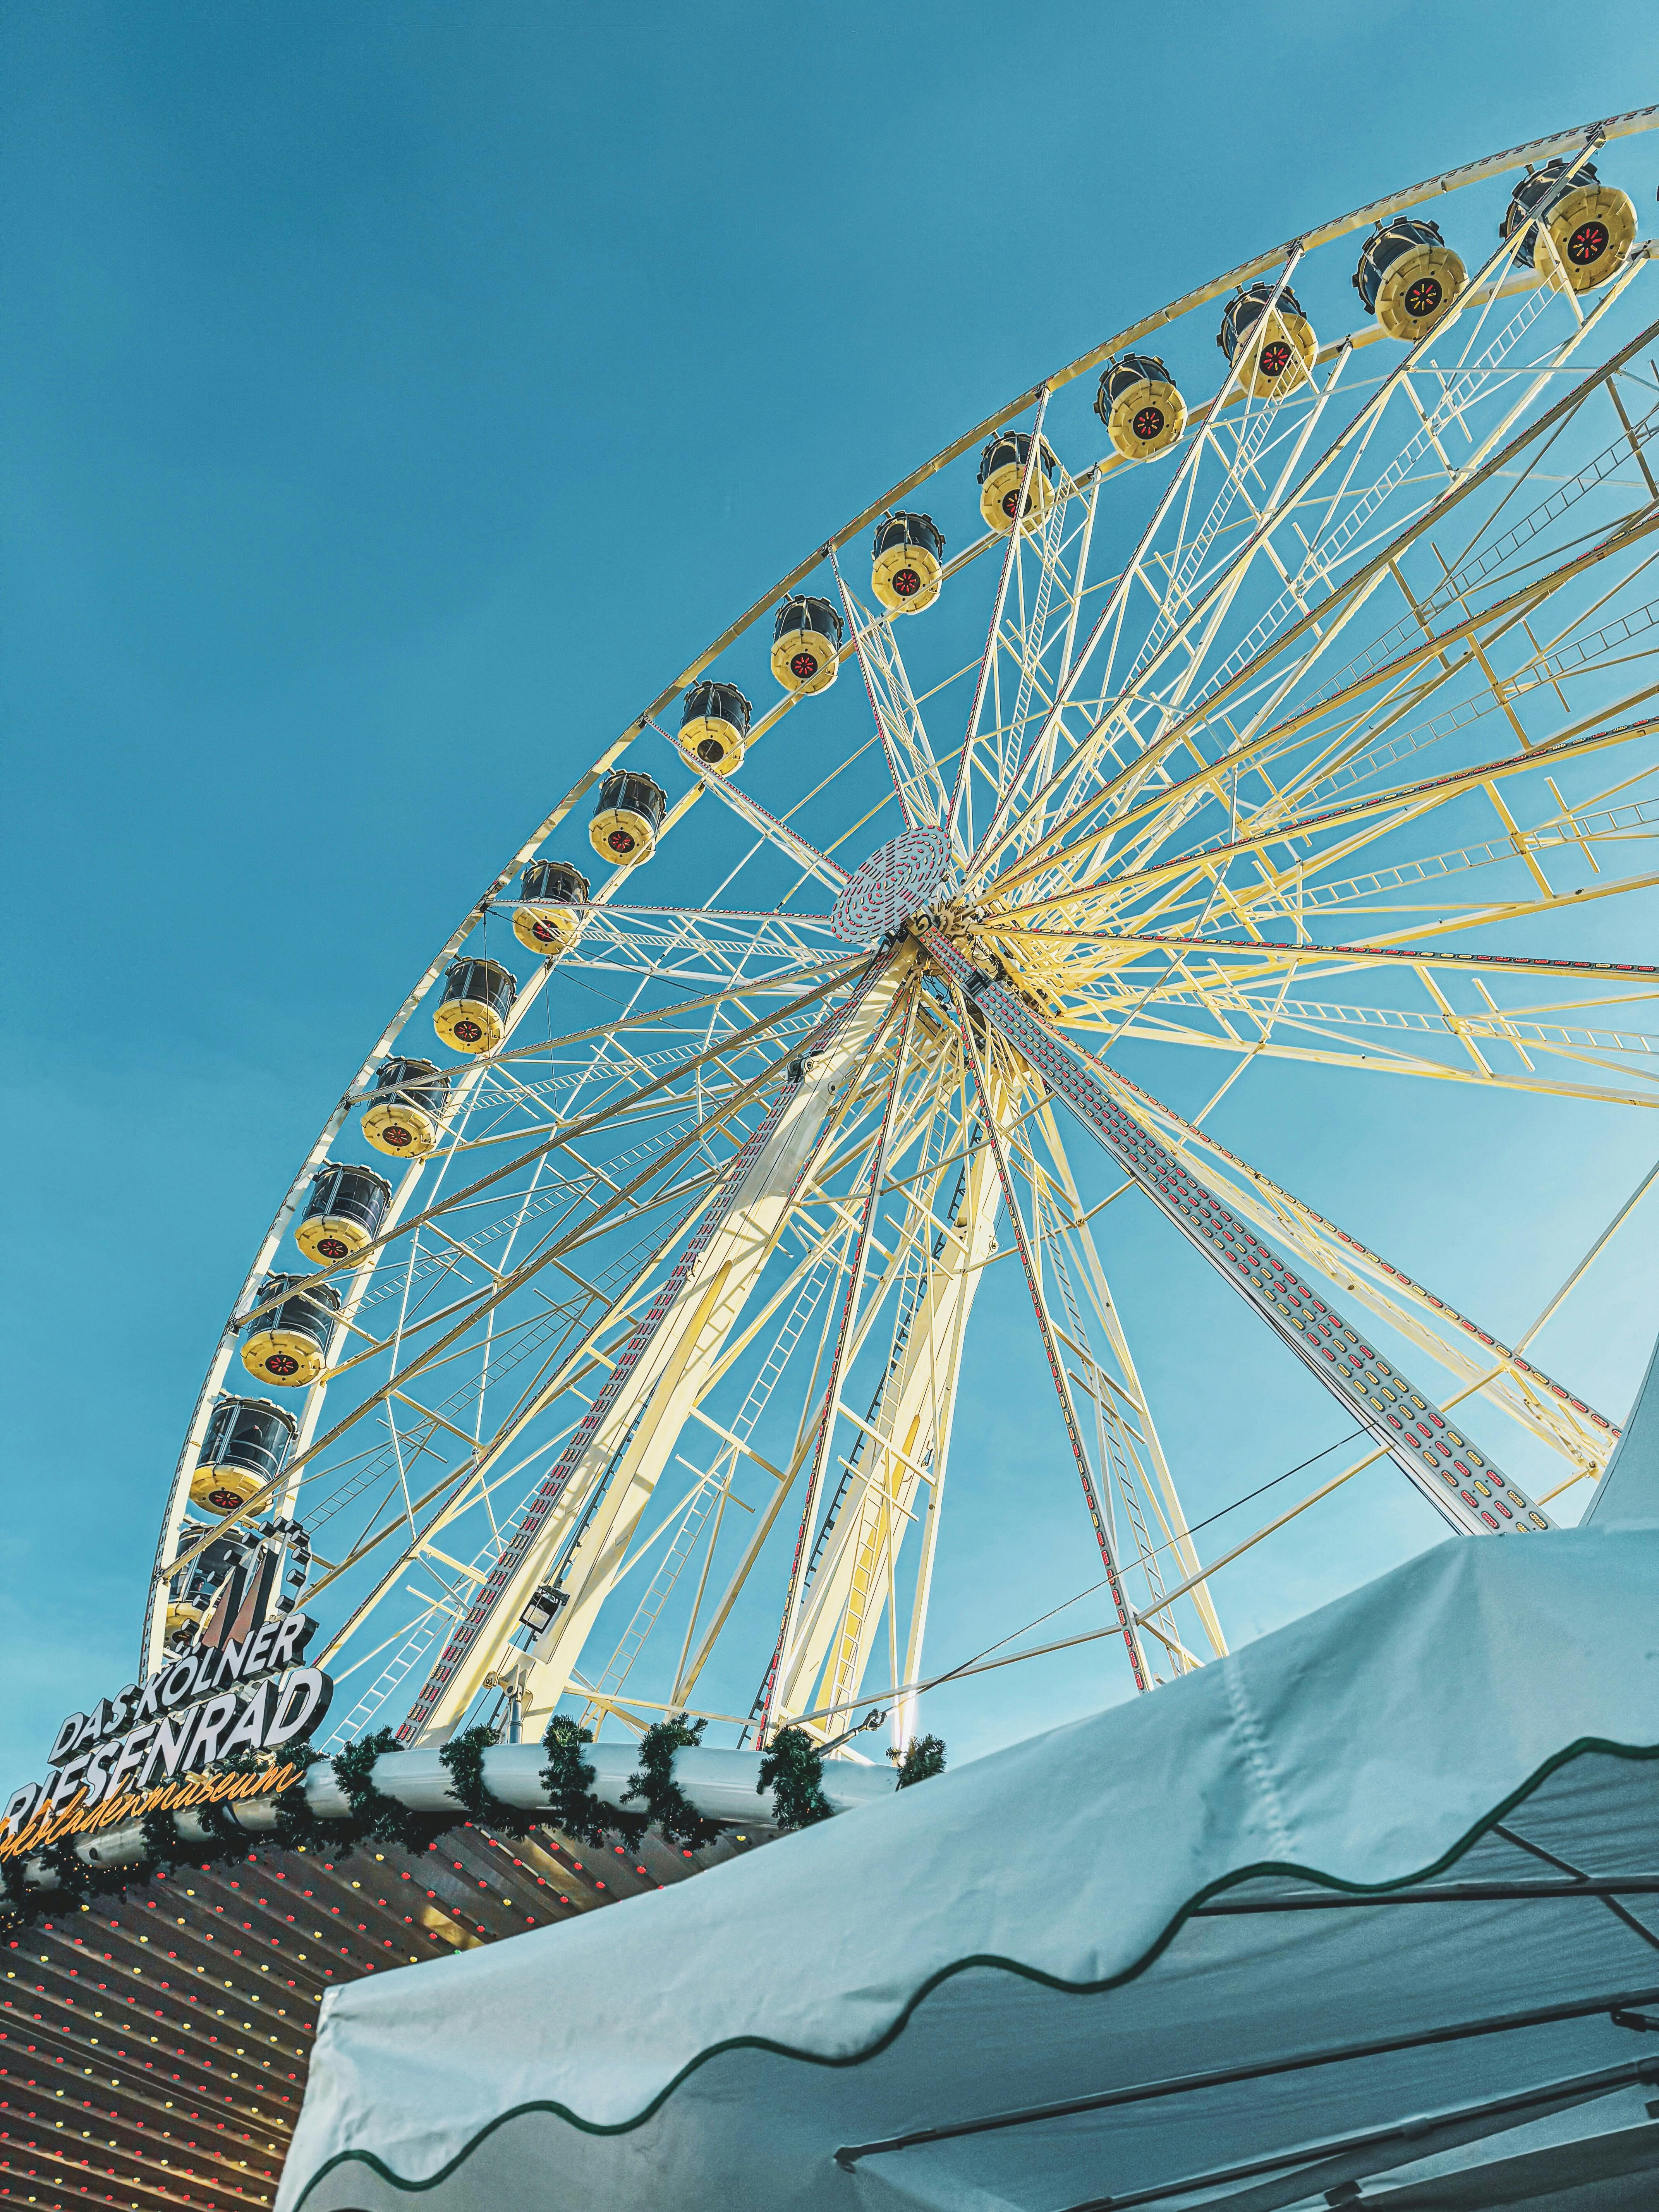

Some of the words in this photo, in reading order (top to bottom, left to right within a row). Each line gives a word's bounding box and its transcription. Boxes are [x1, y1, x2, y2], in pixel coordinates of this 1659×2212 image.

[0, 1667, 323, 1836] RIESENRAD
[47, 1684, 136, 1763] DAS
[133, 1613, 306, 1720] KÖLNER
